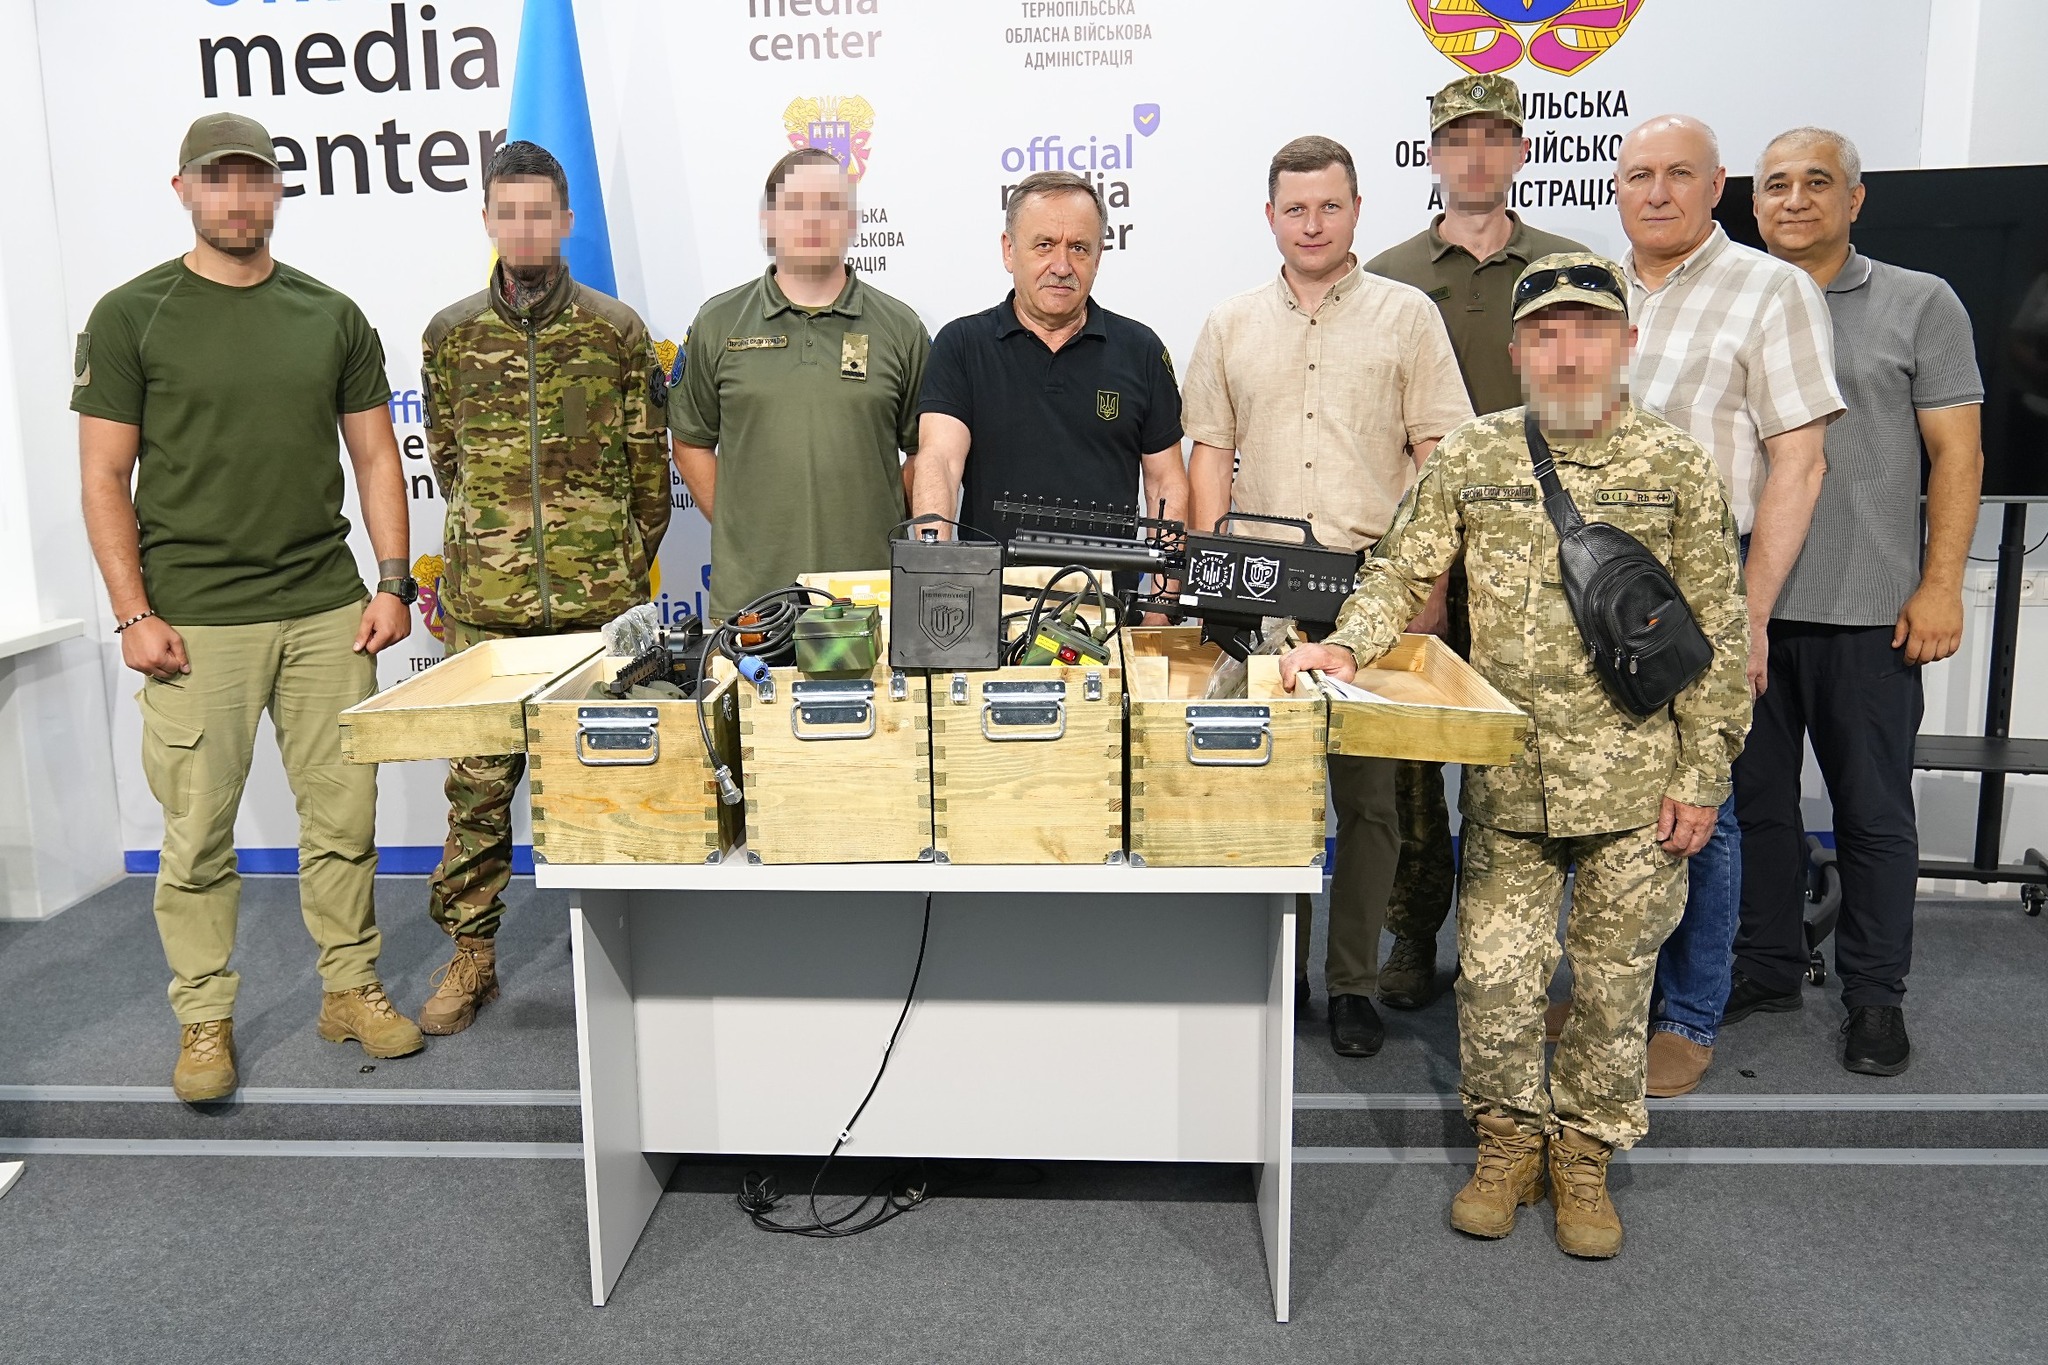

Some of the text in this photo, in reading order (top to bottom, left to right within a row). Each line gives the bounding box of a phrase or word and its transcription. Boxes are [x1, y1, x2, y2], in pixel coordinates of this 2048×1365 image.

[1022, 0, 1135, 18] ТЕРНОПІЛЬСЬКА
[749, 26, 882, 61] center
[1005, 22, 1152, 43] ОБЛАСНА ВІЙСЬКОВА
[199, 3, 500, 98] media
[1024, 49, 1133, 70] АДМІНІСТРАЦІЯ
[271, 119, 507, 197] enter
[1001, 133, 1132, 172] official
[1637, 494, 1649, 502] Rh
